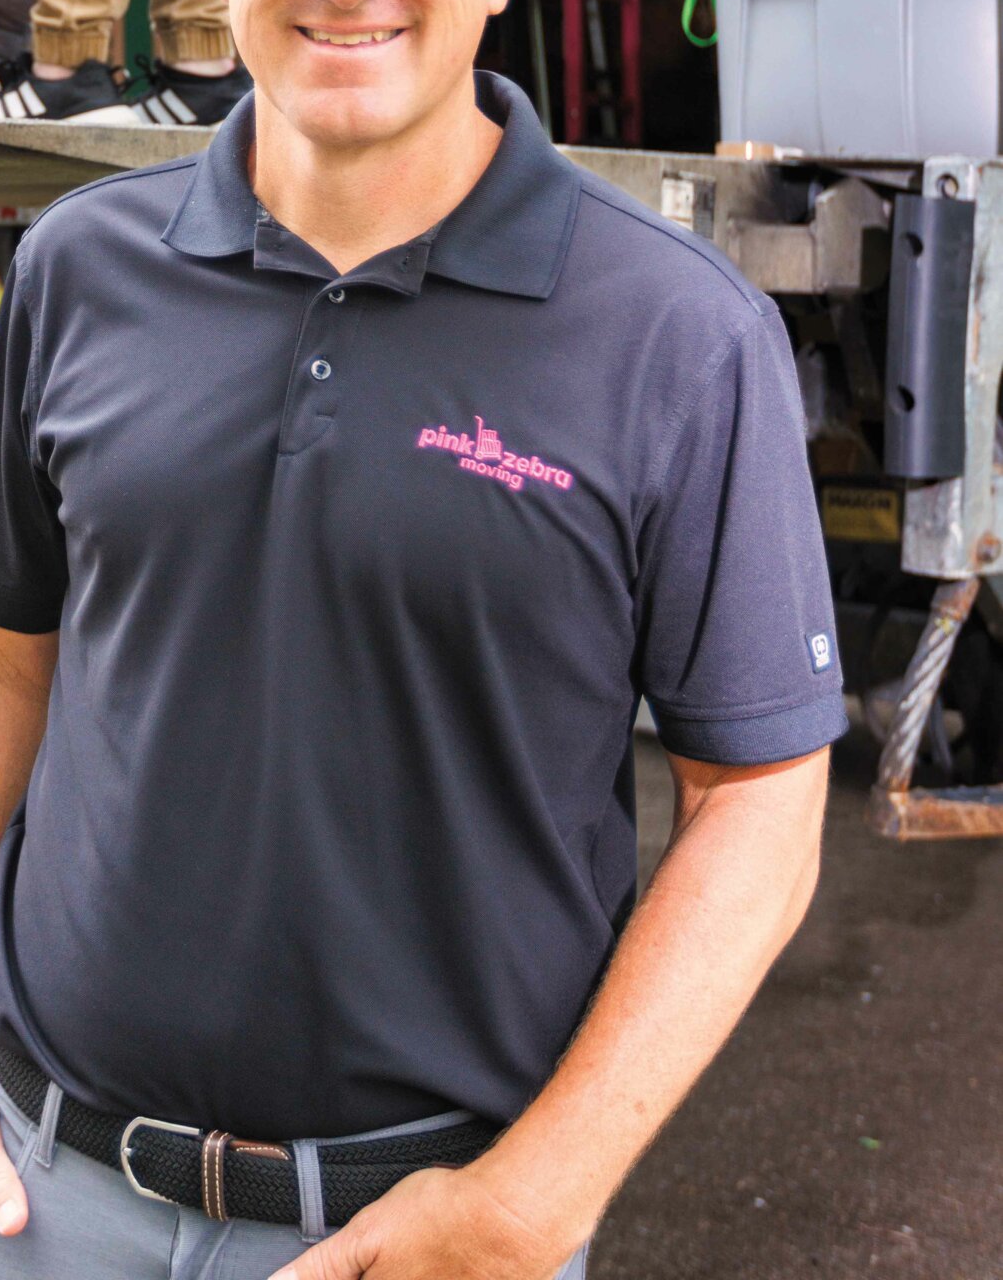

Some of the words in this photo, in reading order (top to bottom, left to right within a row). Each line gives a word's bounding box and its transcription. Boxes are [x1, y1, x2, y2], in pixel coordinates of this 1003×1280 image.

[417, 425, 475, 454] pink
[501, 451, 573, 490] zebra
[459, 458, 524, 491] moving
